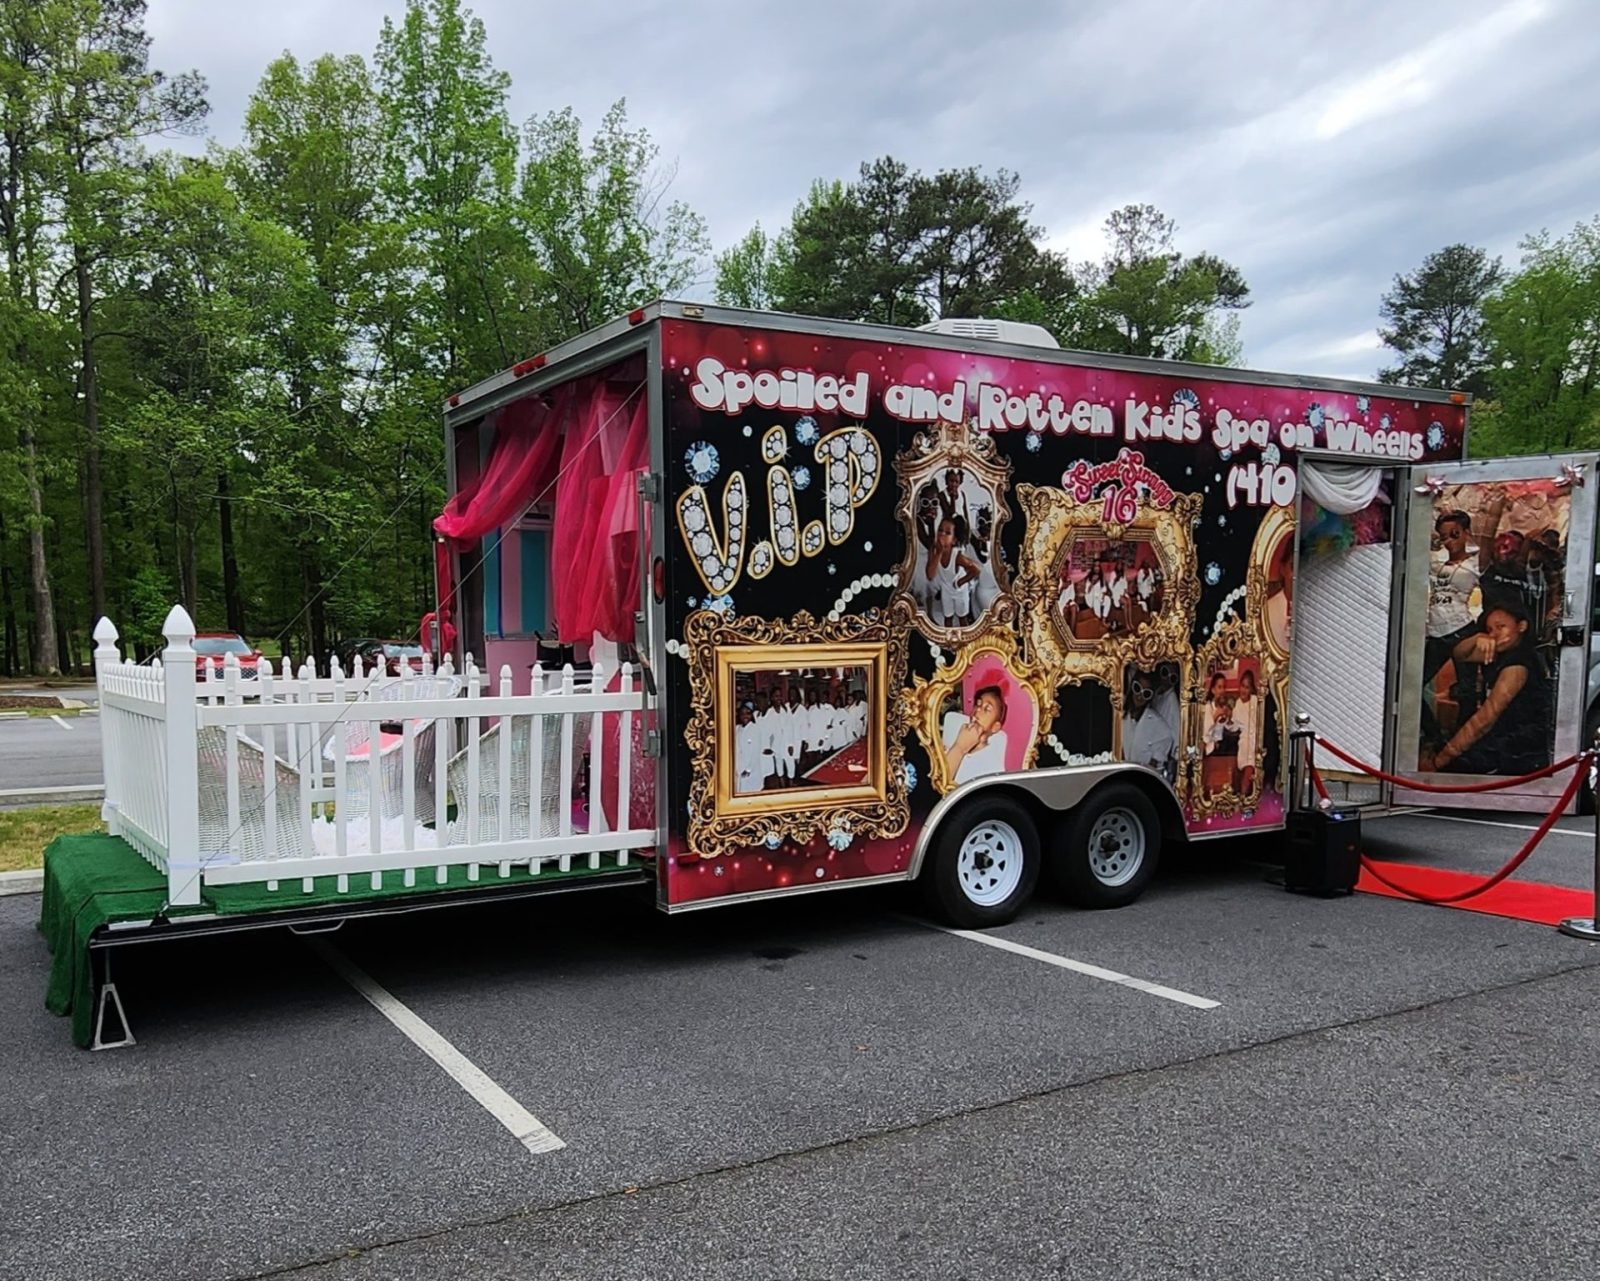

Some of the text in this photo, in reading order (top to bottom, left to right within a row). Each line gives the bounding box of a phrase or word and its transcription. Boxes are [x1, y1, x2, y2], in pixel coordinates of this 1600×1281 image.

[692, 357, 1424, 460] Spoiled and Rotten Kids Spa on Wheels
[1062, 460, 1121, 504] Sweet
[1101, 484, 1138, 525] 16
[1226, 462, 1297, 508] (410
